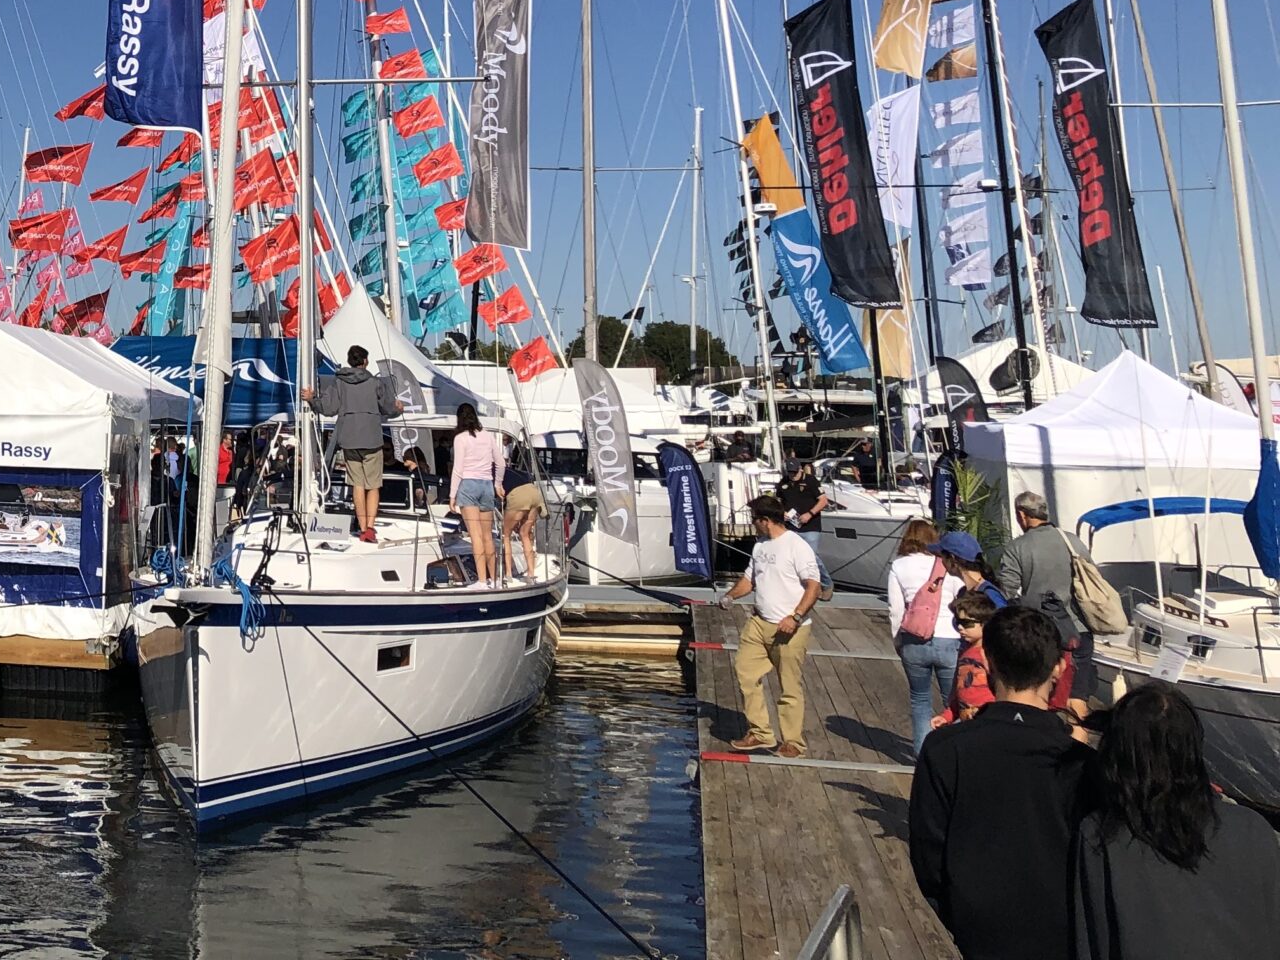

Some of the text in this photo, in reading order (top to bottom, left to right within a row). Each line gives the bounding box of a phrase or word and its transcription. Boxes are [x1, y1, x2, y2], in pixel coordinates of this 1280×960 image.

[473, 49, 508, 150] Moody
[680, 475, 697, 541] West Marine
